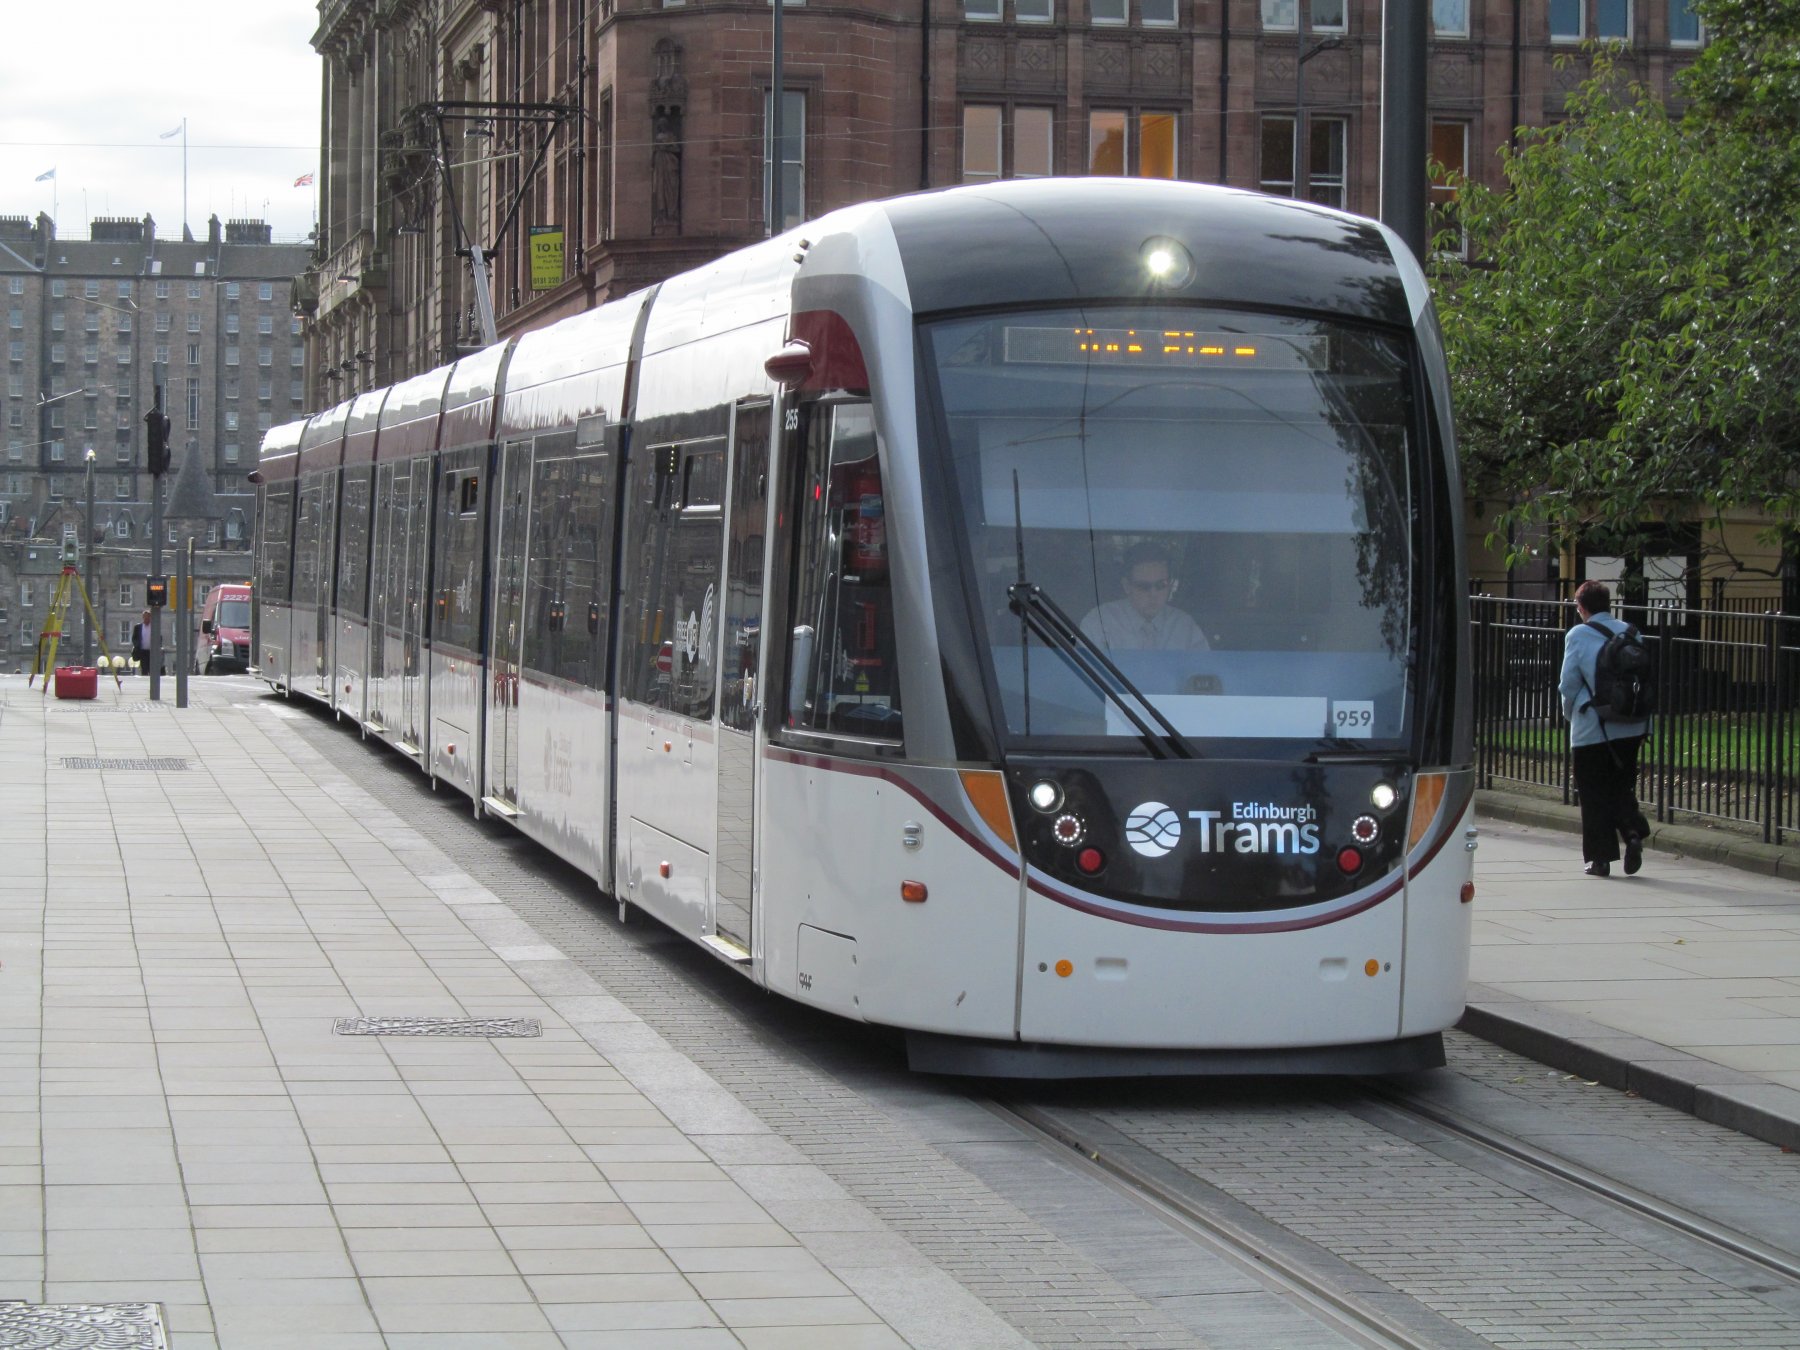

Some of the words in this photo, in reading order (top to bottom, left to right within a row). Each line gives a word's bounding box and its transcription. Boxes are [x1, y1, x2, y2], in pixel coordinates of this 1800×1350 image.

[536, 243, 550, 252] TO
[785, 408, 799, 430] 255
[1336, 710, 1371, 727] 959
[1233, 802, 1317, 822] Edinburgh
[1188, 810, 1320, 854] Trams
